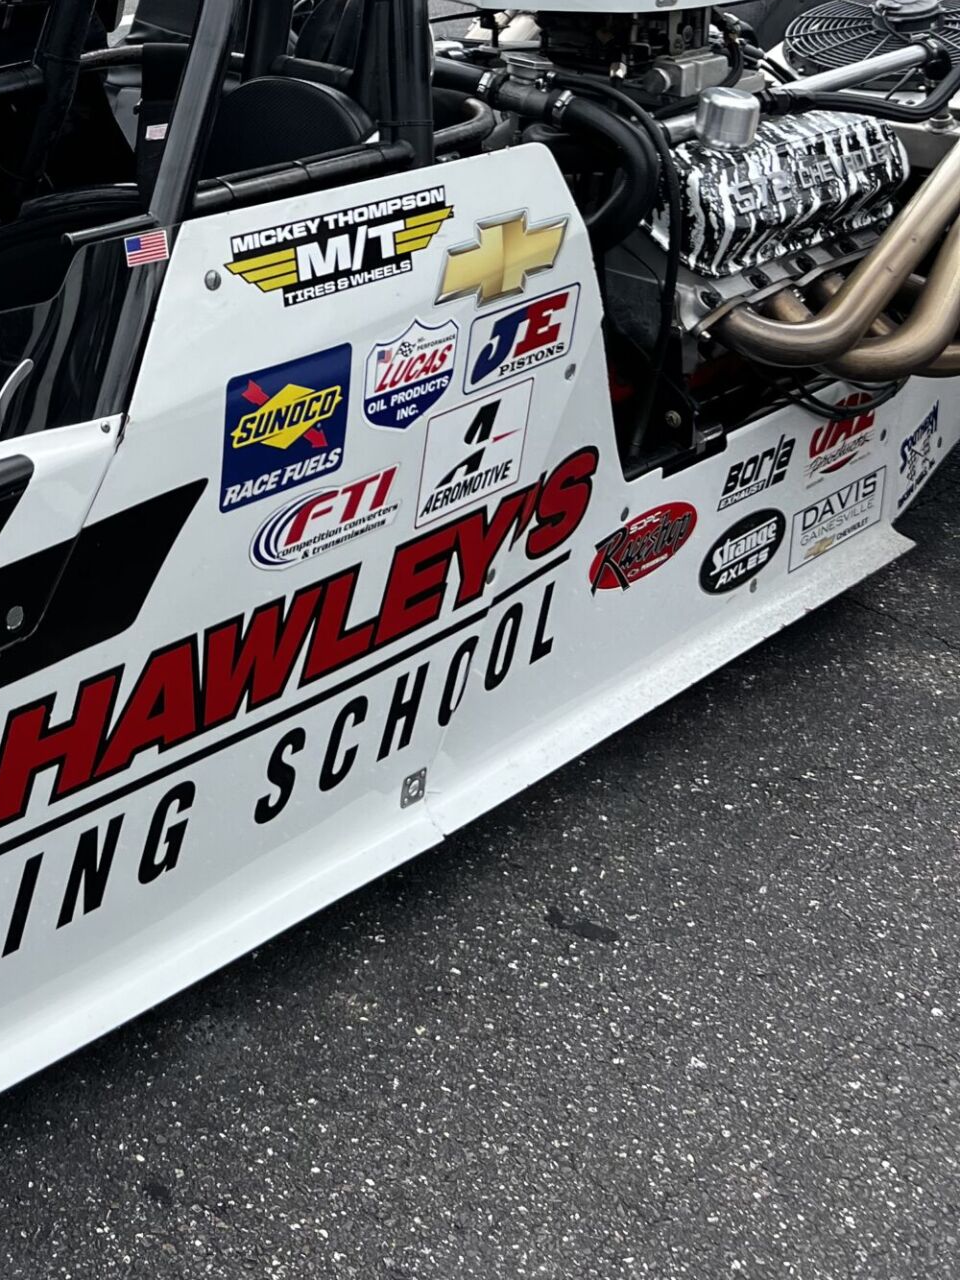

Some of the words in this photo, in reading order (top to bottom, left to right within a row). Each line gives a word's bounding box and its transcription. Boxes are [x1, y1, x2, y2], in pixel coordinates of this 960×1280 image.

[232, 218, 321, 254] MICKEY
[323, 187, 445, 230] THOMPSON
[295, 219, 406, 282] M/T
[284, 282, 336, 305] TIRES
[337, 277, 349, 291] &
[349, 259, 411, 286] WHEELS
[470, 291, 571, 386] JE
[497, 341, 565, 377] PISTONS
[367, 399, 388, 415] OIL
[390, 375, 450, 407] PRODUCTS
[374, 343, 453, 394] LUCAS
[235, 388, 338, 445] SUNOCO
[396, 404, 419, 421] INC.
[222, 469, 282, 507] RACE
[281, 447, 342, 486] FUELS
[418, 458, 513, 518] AEROMOTIVE
[720, 480, 766, 510] EXHAUST
[802, 472, 877, 531] DAVIS
[275, 526, 342, 560] competition
[343, 503, 398, 532] converters
[283, 465, 398, 548] FTI
[800, 498, 875, 546] GAINESVILLE
[312, 518, 386, 555] transmissions
[710, 522, 778, 576] Strange
[715, 547, 770, 589] AXLES
[253, 580, 557, 825] SCHOOL
